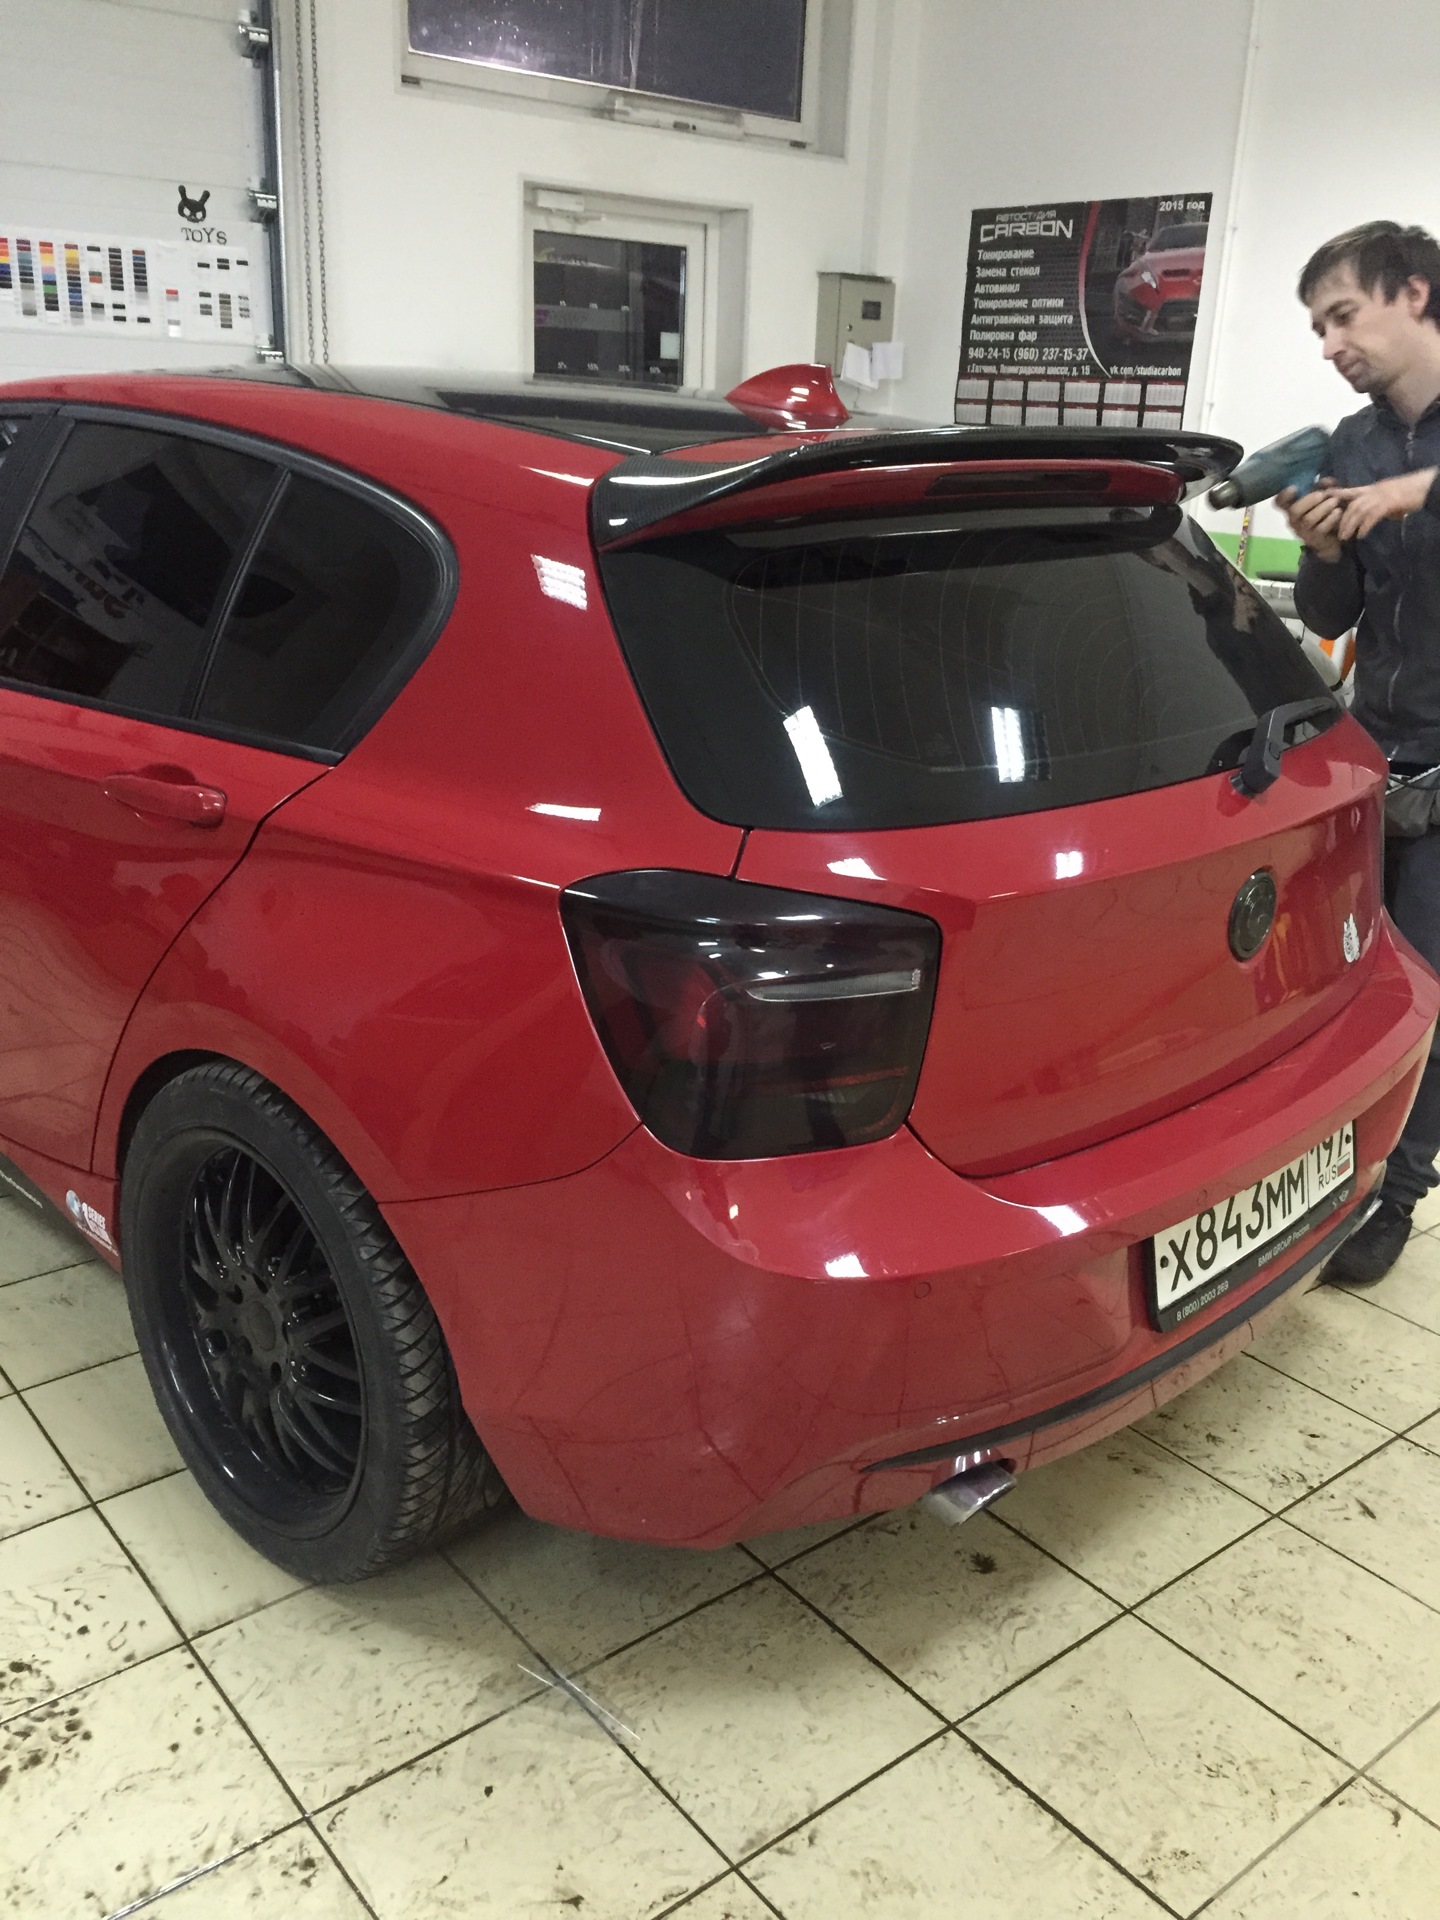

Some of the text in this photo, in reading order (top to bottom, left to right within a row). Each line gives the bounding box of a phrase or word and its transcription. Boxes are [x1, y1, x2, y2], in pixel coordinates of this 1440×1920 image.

[1159, 200, 1205, 212] 2015 год
[181, 227, 228, 245] TOYS
[980, 219, 1073, 242] CARBON
[977, 248, 1035, 261] Тонирование
[975, 265, 1040, 278] Замена стекол
[974, 282, 1020, 294] Автовинил
[973, 297, 1064, 310] Тонирование оптики
[970, 313, 1074, 326] Антигравийная защита
[969, 329, 1038, 342] Полировка фар
[968, 347, 1089, 361] 940-24-15 (960) 237-15-37
[1109, 364, 1182, 377] vk.com/studiacarbon
[1318, 1164, 1337, 1190] RUS
[1257, 1249, 1273, 1267] BMW
[1176, 1310, 1182, 1322] 8
[1182, 1299, 1200, 1319] (800)
[1200, 1288, 1217, 1307] 2003
